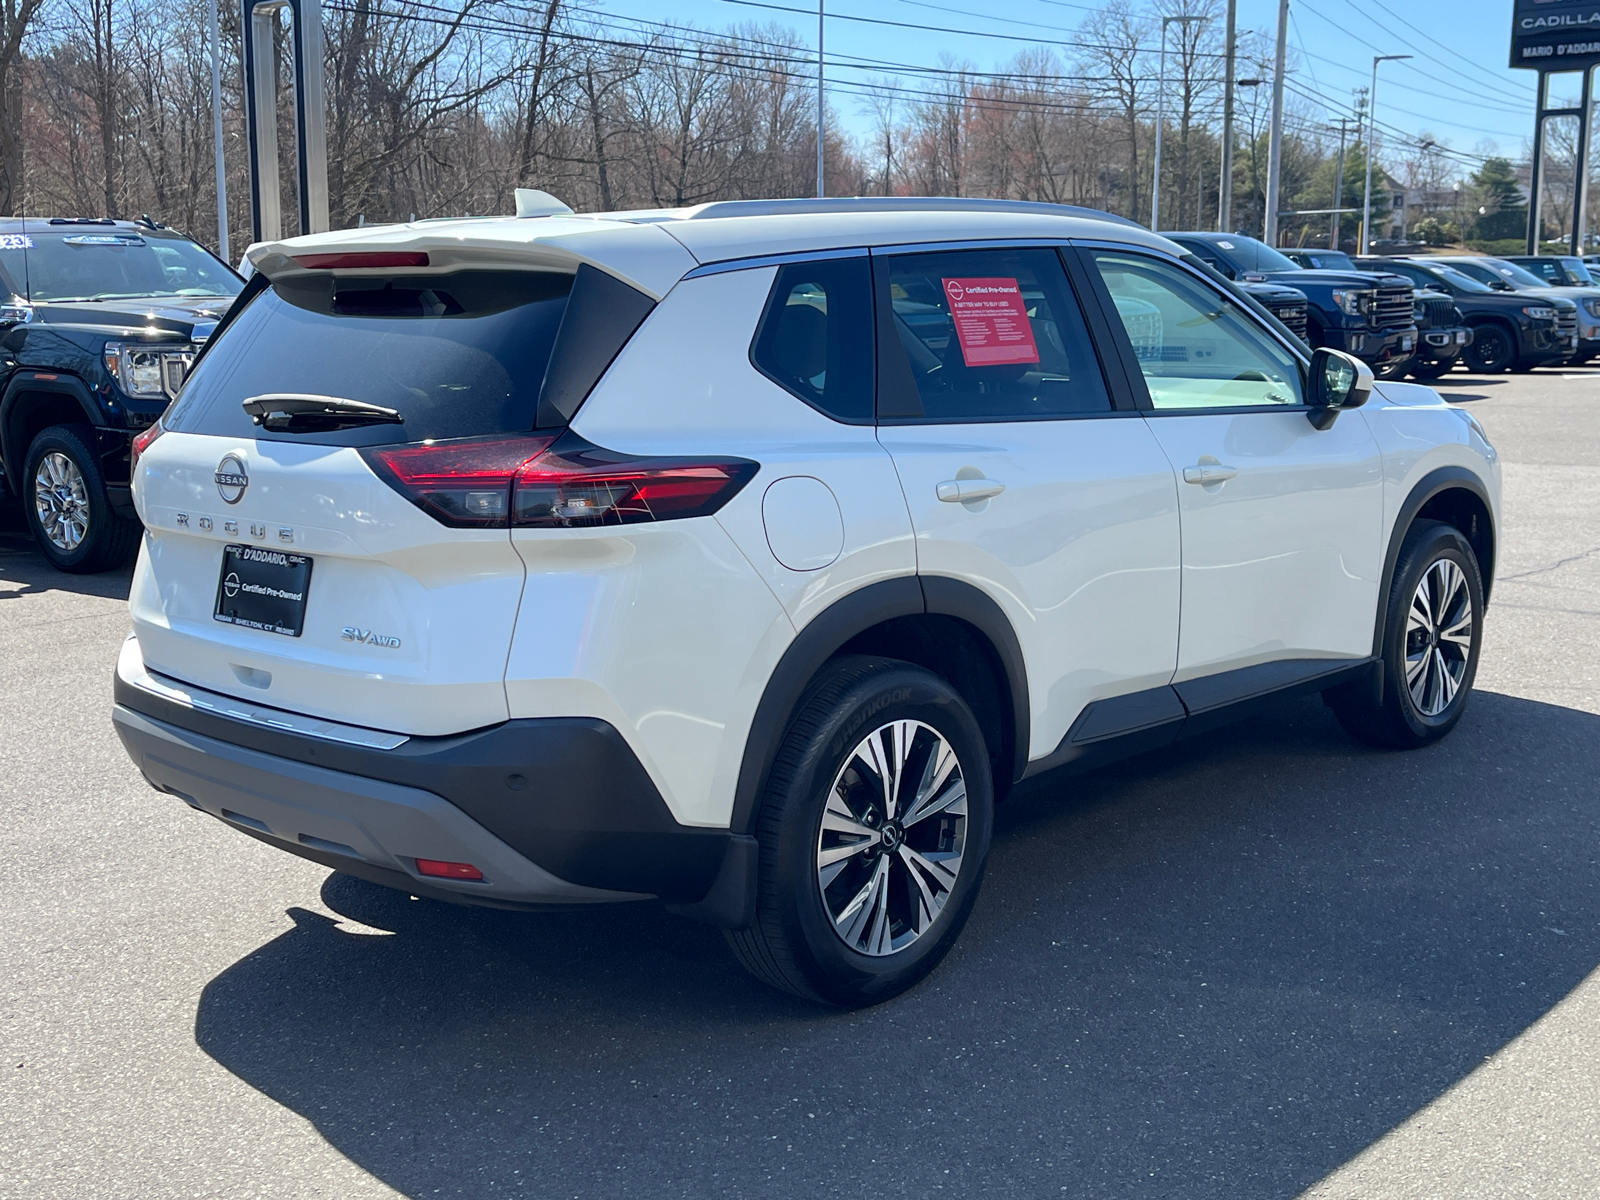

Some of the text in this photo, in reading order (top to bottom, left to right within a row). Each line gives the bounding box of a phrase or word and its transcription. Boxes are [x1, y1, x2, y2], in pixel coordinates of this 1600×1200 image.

[1521, 12, 1600, 29] CADILLA
[1522, 45, 1553, 58] MARIO
[3, 237, 24, 246] 23
[215, 475, 247, 485] NSSAN
[176, 511, 294, 544] ROGUE
[243, 548, 286, 566] D'ADDARIO
[289, 556, 306, 564] GMC
[241, 582, 303, 601] Certified Pre-Owned
